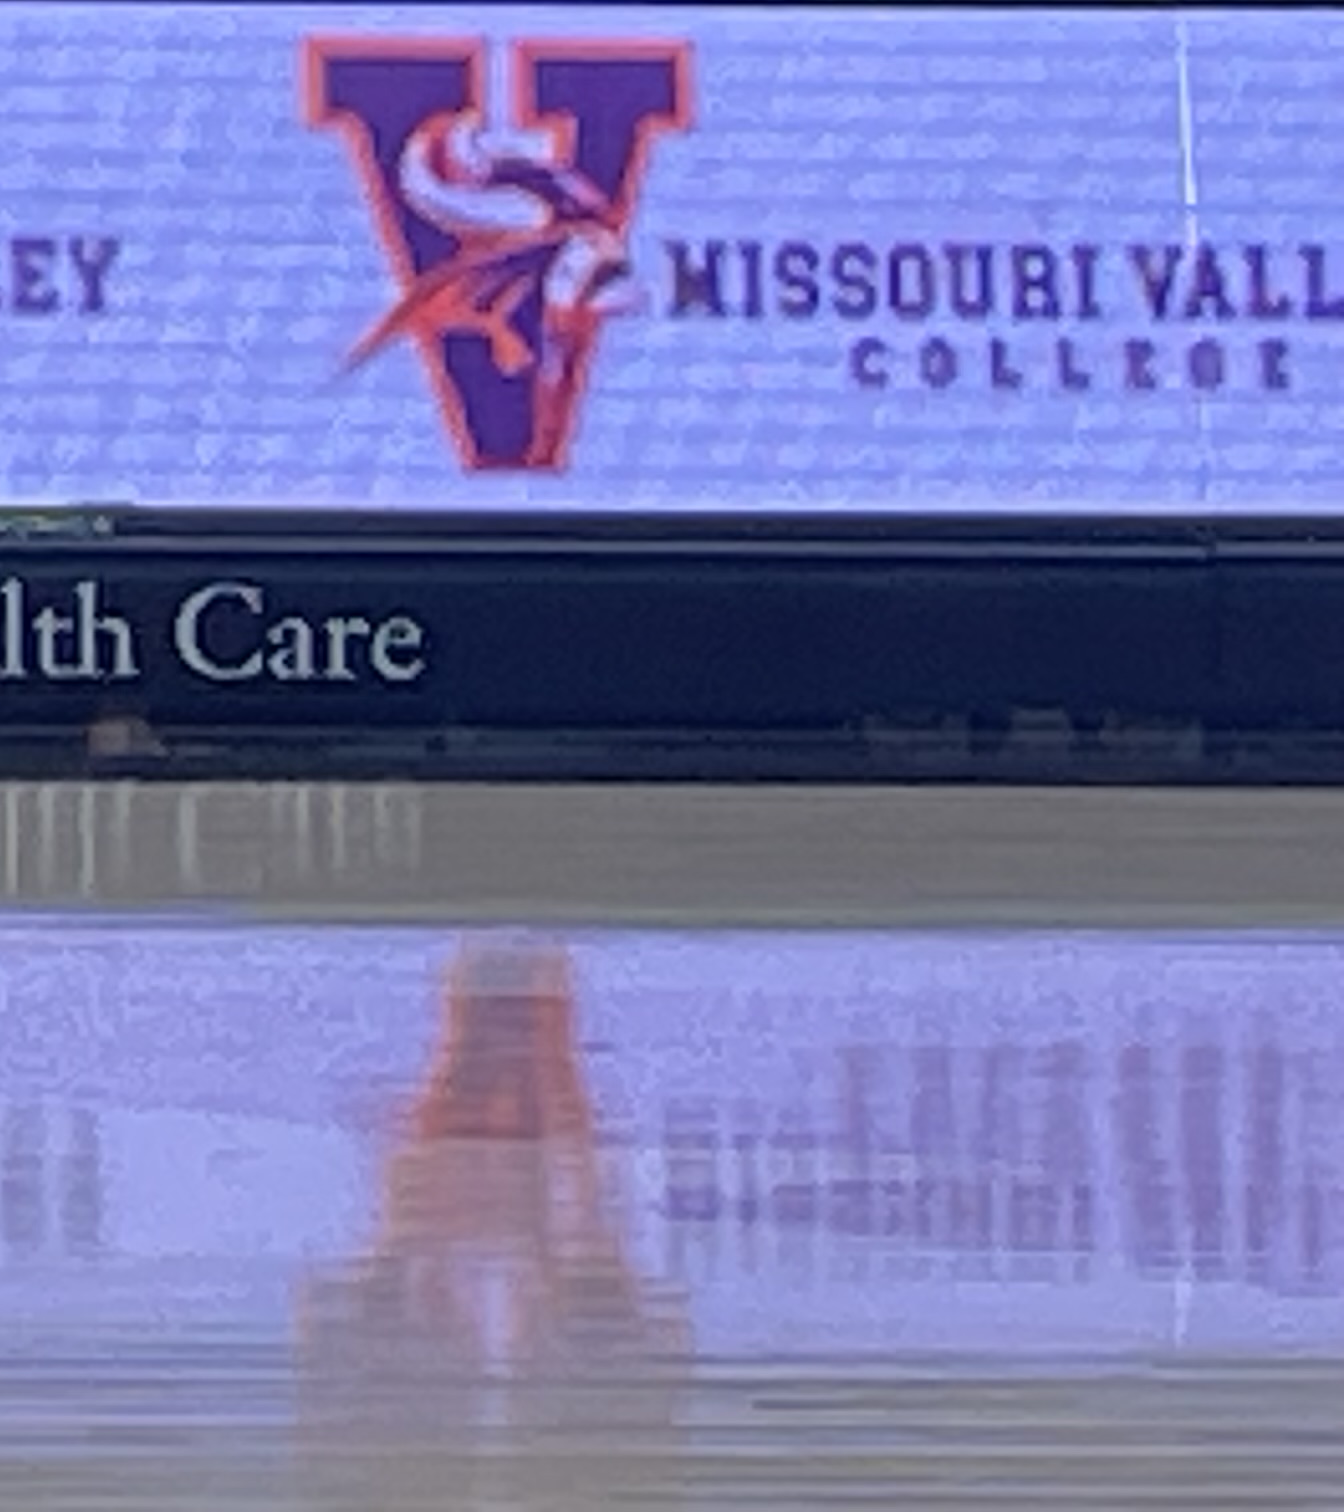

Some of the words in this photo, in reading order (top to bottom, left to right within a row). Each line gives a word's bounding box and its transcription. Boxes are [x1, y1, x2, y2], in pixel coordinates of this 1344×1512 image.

[666, 241, 1104, 320] MISSOURI
[848, 336, 1292, 390] COLLEGE
[174, 581, 426, 682] Care
